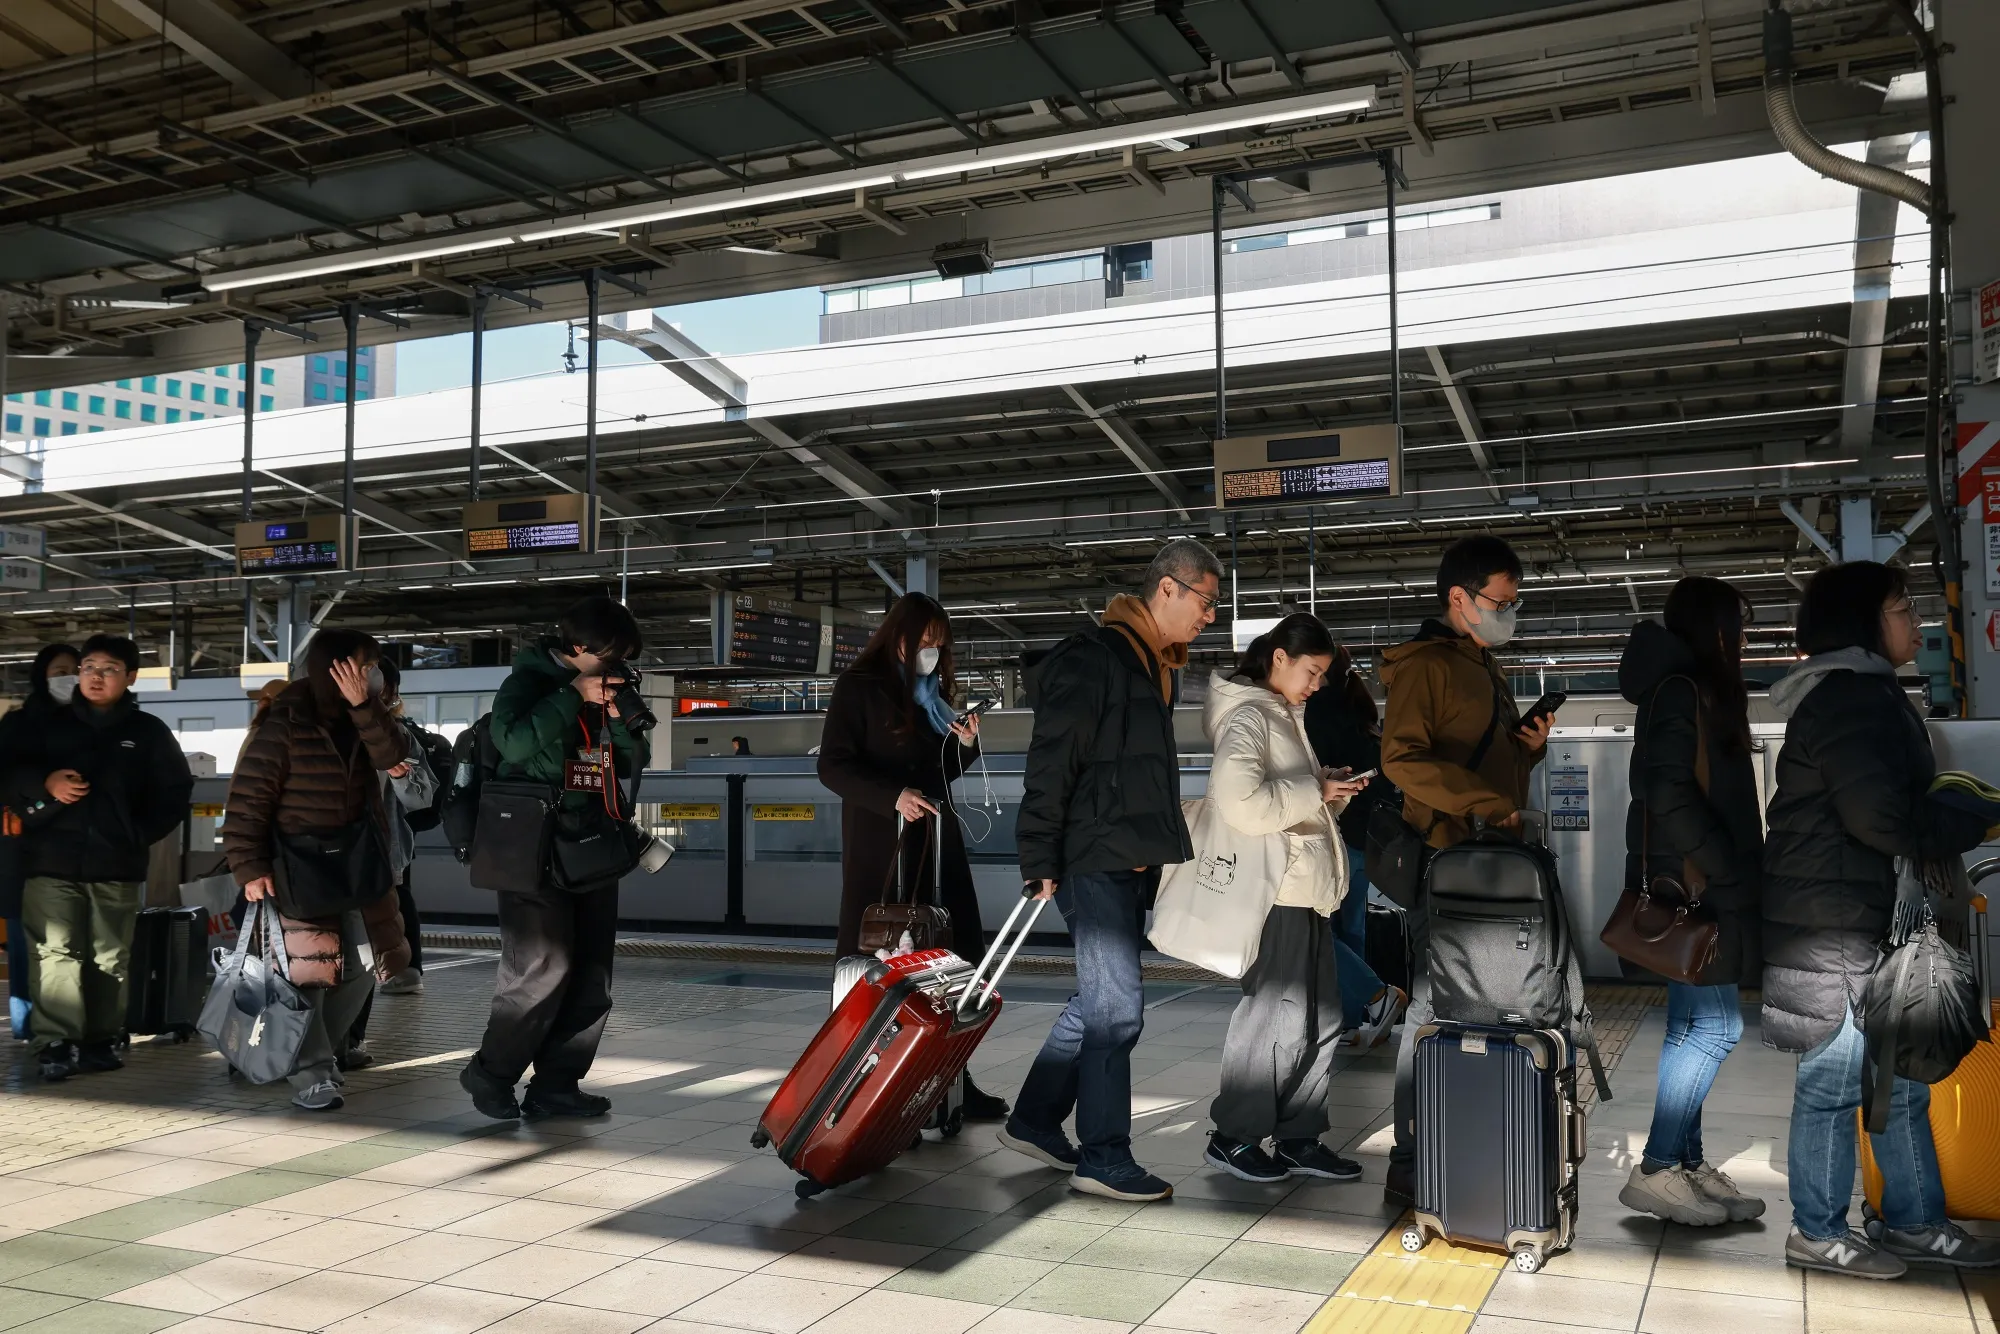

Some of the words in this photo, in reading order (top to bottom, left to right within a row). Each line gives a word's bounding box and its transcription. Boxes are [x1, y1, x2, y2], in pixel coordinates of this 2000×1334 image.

[1281, 468, 1316, 482] 10:50
[1281, 480, 1316, 494] 11:02
[507, 527, 531, 538] 10:50
[508, 537, 531, 548] 11:02
[603, 751, 611, 768] EOS
[572, 774, 602, 787] 共同通
[1562, 796, 1570, 806] 4
[1929, 1233, 1962, 1256] N
[1825, 1242, 1859, 1266] N
